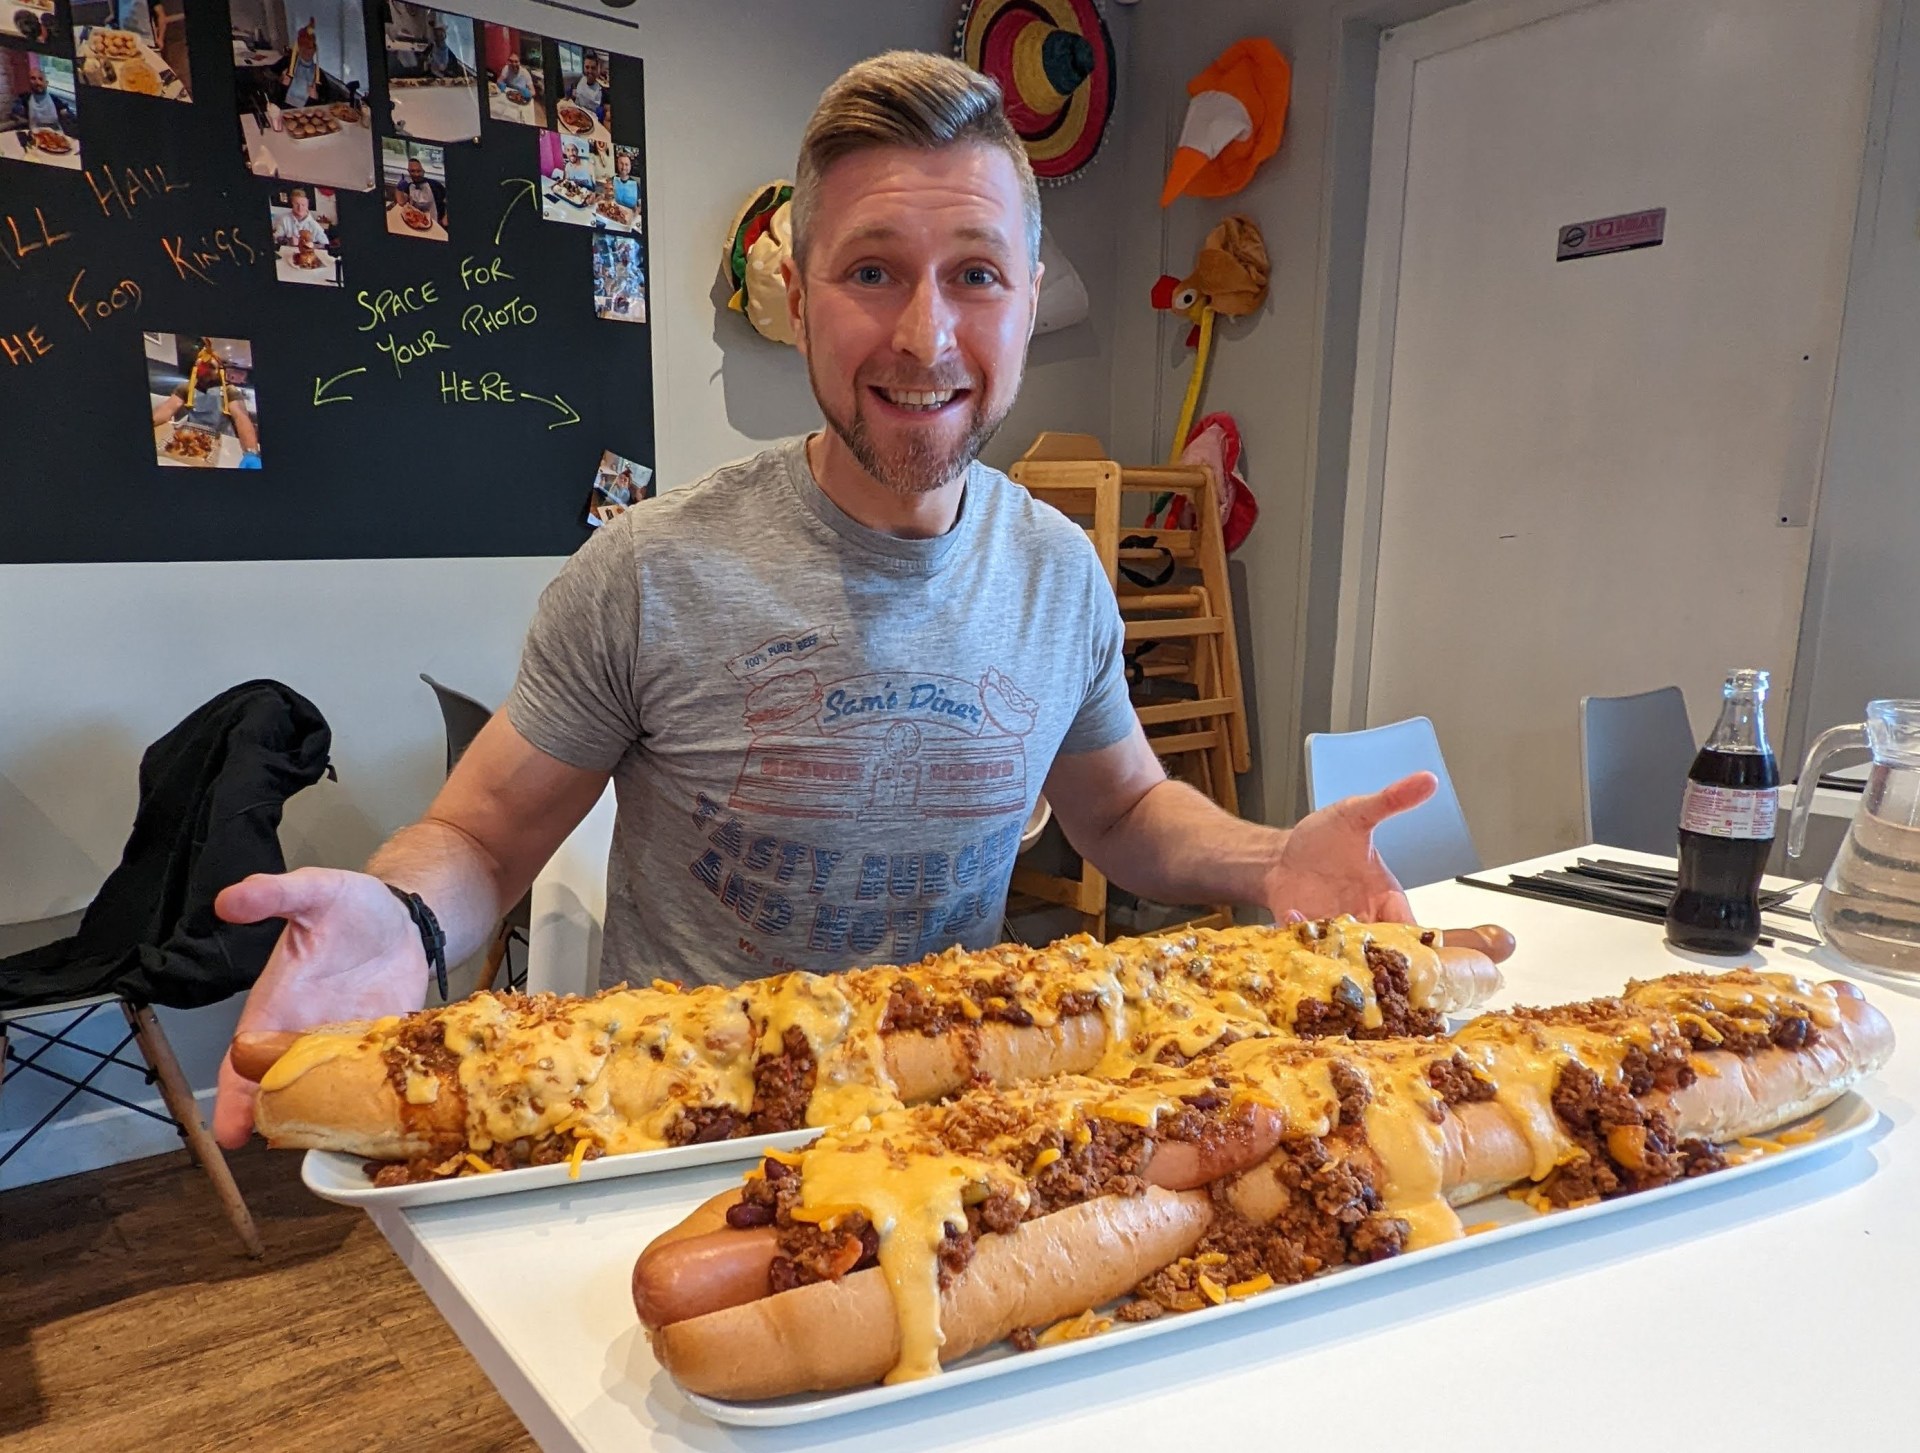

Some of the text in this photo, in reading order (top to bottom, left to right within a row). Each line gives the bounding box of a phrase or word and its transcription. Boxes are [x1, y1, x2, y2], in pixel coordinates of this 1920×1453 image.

[85, 164, 190, 219] HAIL
[68, 268, 142, 331] FOOD
[358, 256, 515, 331] SPACE FOR
[376, 297, 538, 379] YOUR PHOTO
[441, 370, 515, 404] HERE
[744, 633, 819, 669] 100% PURE BEEF
[823, 682, 983, 724] Sam's Diner
[692, 791, 849, 896] TASTY
[689, 847, 794, 936] AND
